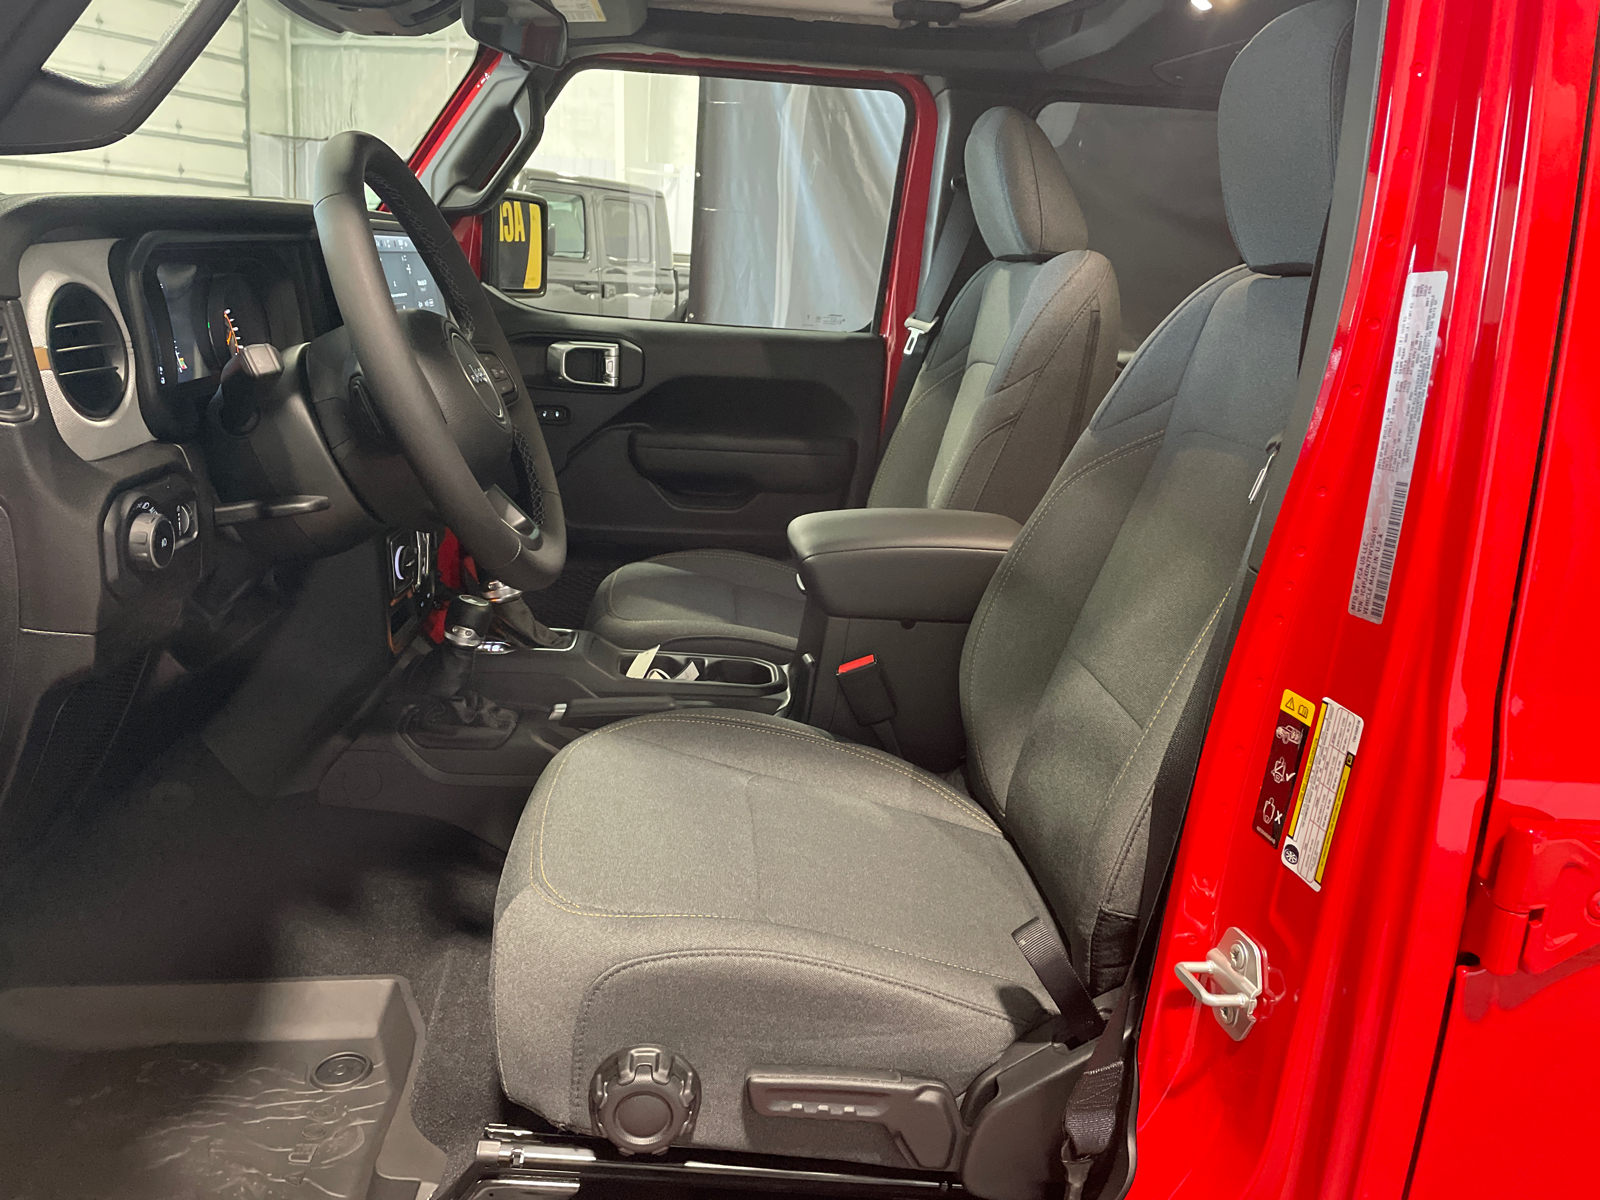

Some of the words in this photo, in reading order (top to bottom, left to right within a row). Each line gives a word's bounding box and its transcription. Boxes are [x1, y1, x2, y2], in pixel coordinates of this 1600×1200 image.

[1359, 555, 1365, 565] US
[1363, 587, 1372, 614] VEHICLE
[1368, 566, 1376, 585] MADE
